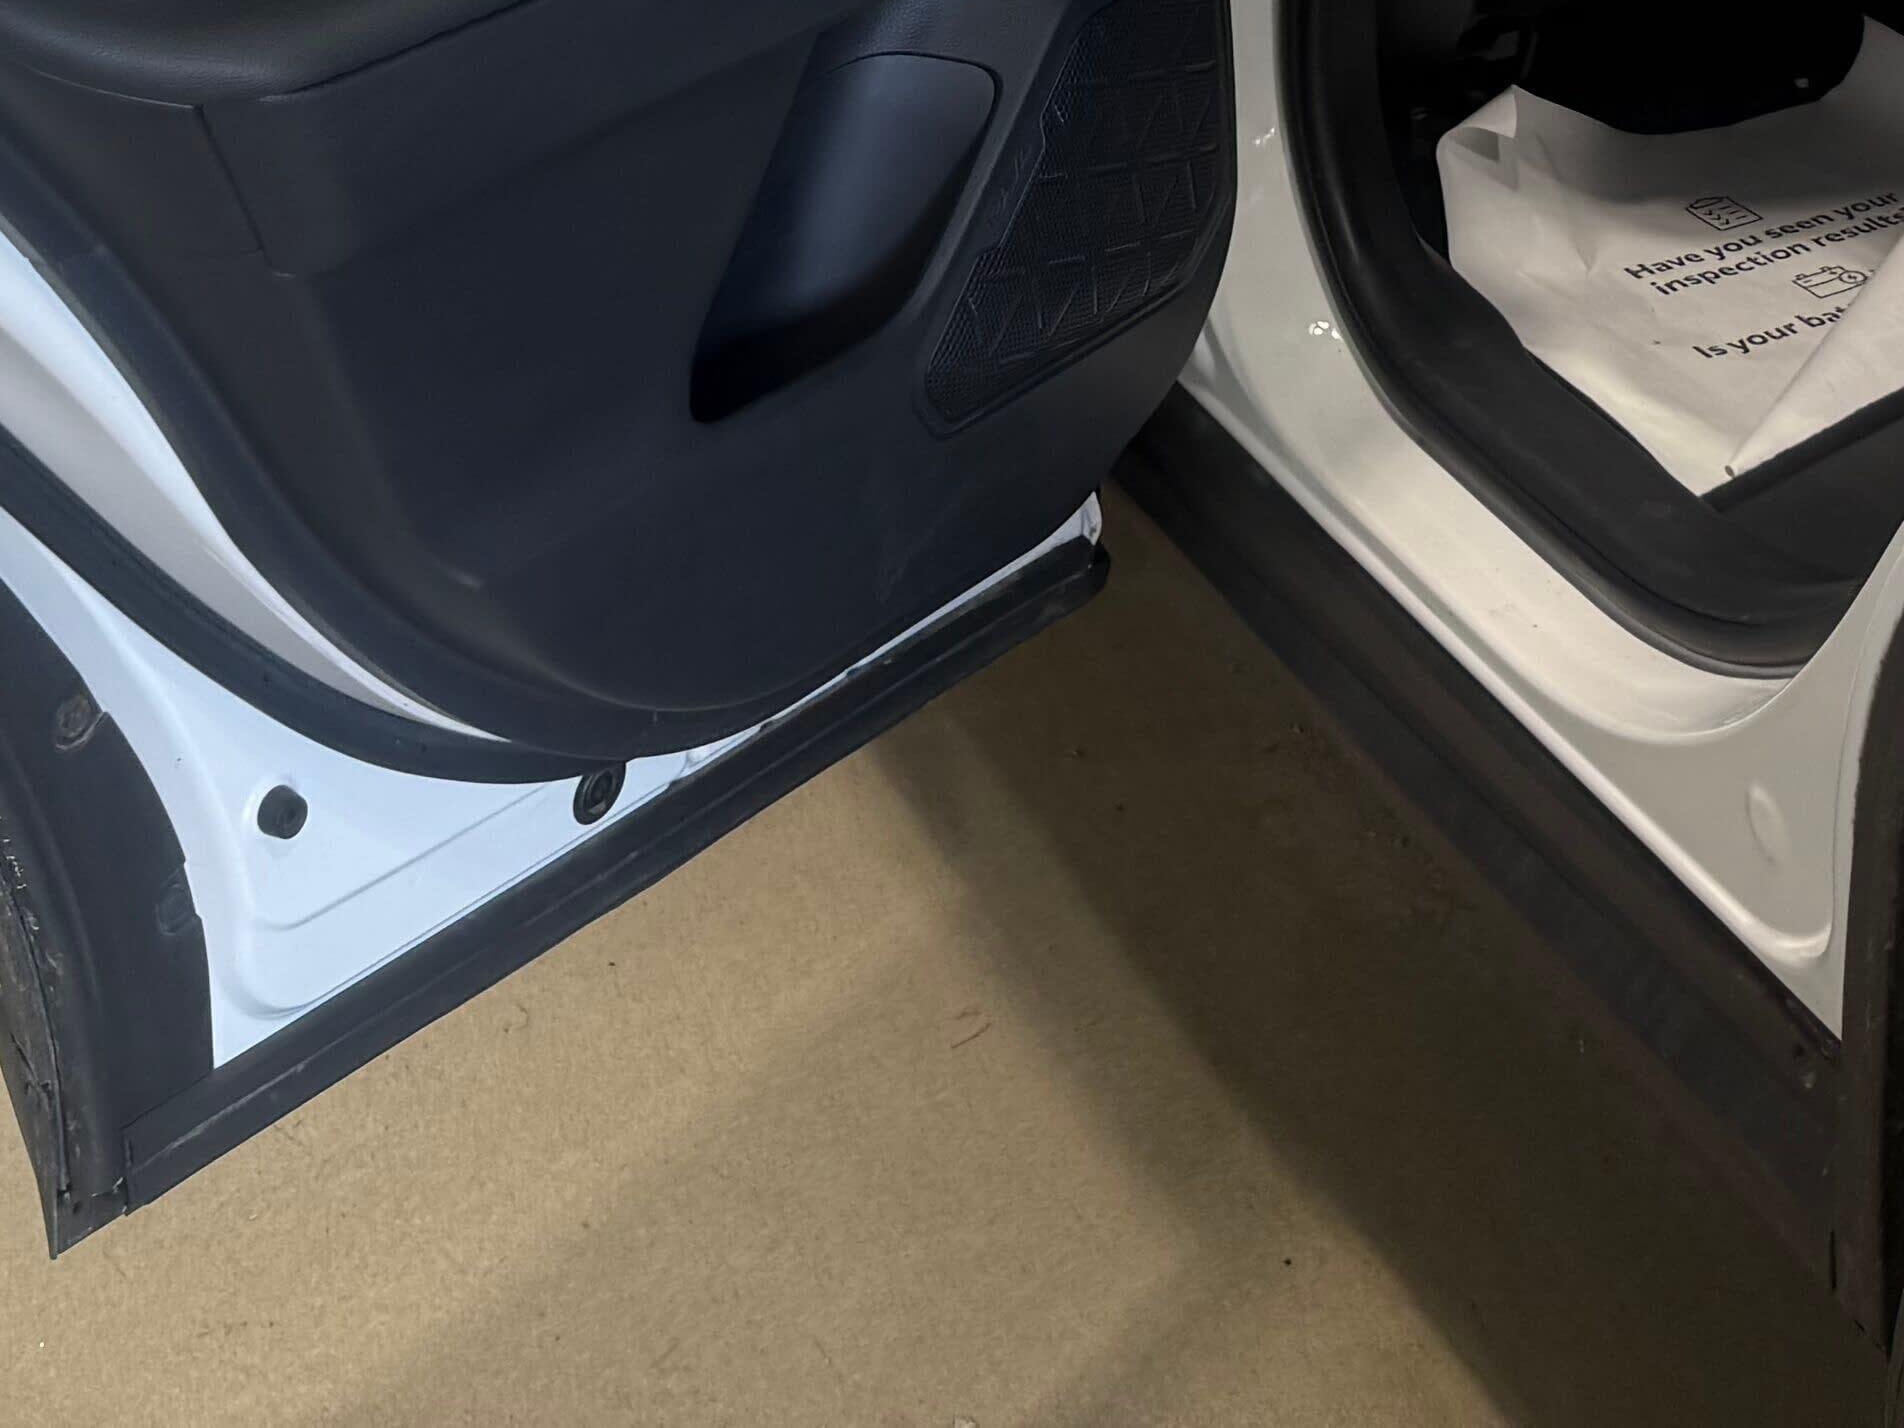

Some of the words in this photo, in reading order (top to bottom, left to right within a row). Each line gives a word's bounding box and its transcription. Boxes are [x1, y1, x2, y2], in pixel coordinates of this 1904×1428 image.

[1623, 252, 1705, 279] Have
[1703, 234, 1763, 261] you
[1765, 213, 1834, 239] seen
[1833, 192, 1900, 220] your
[1650, 242, 1811, 295] inspection
[1692, 345, 1728, 359] Is
[1725, 322, 1798, 354] your
